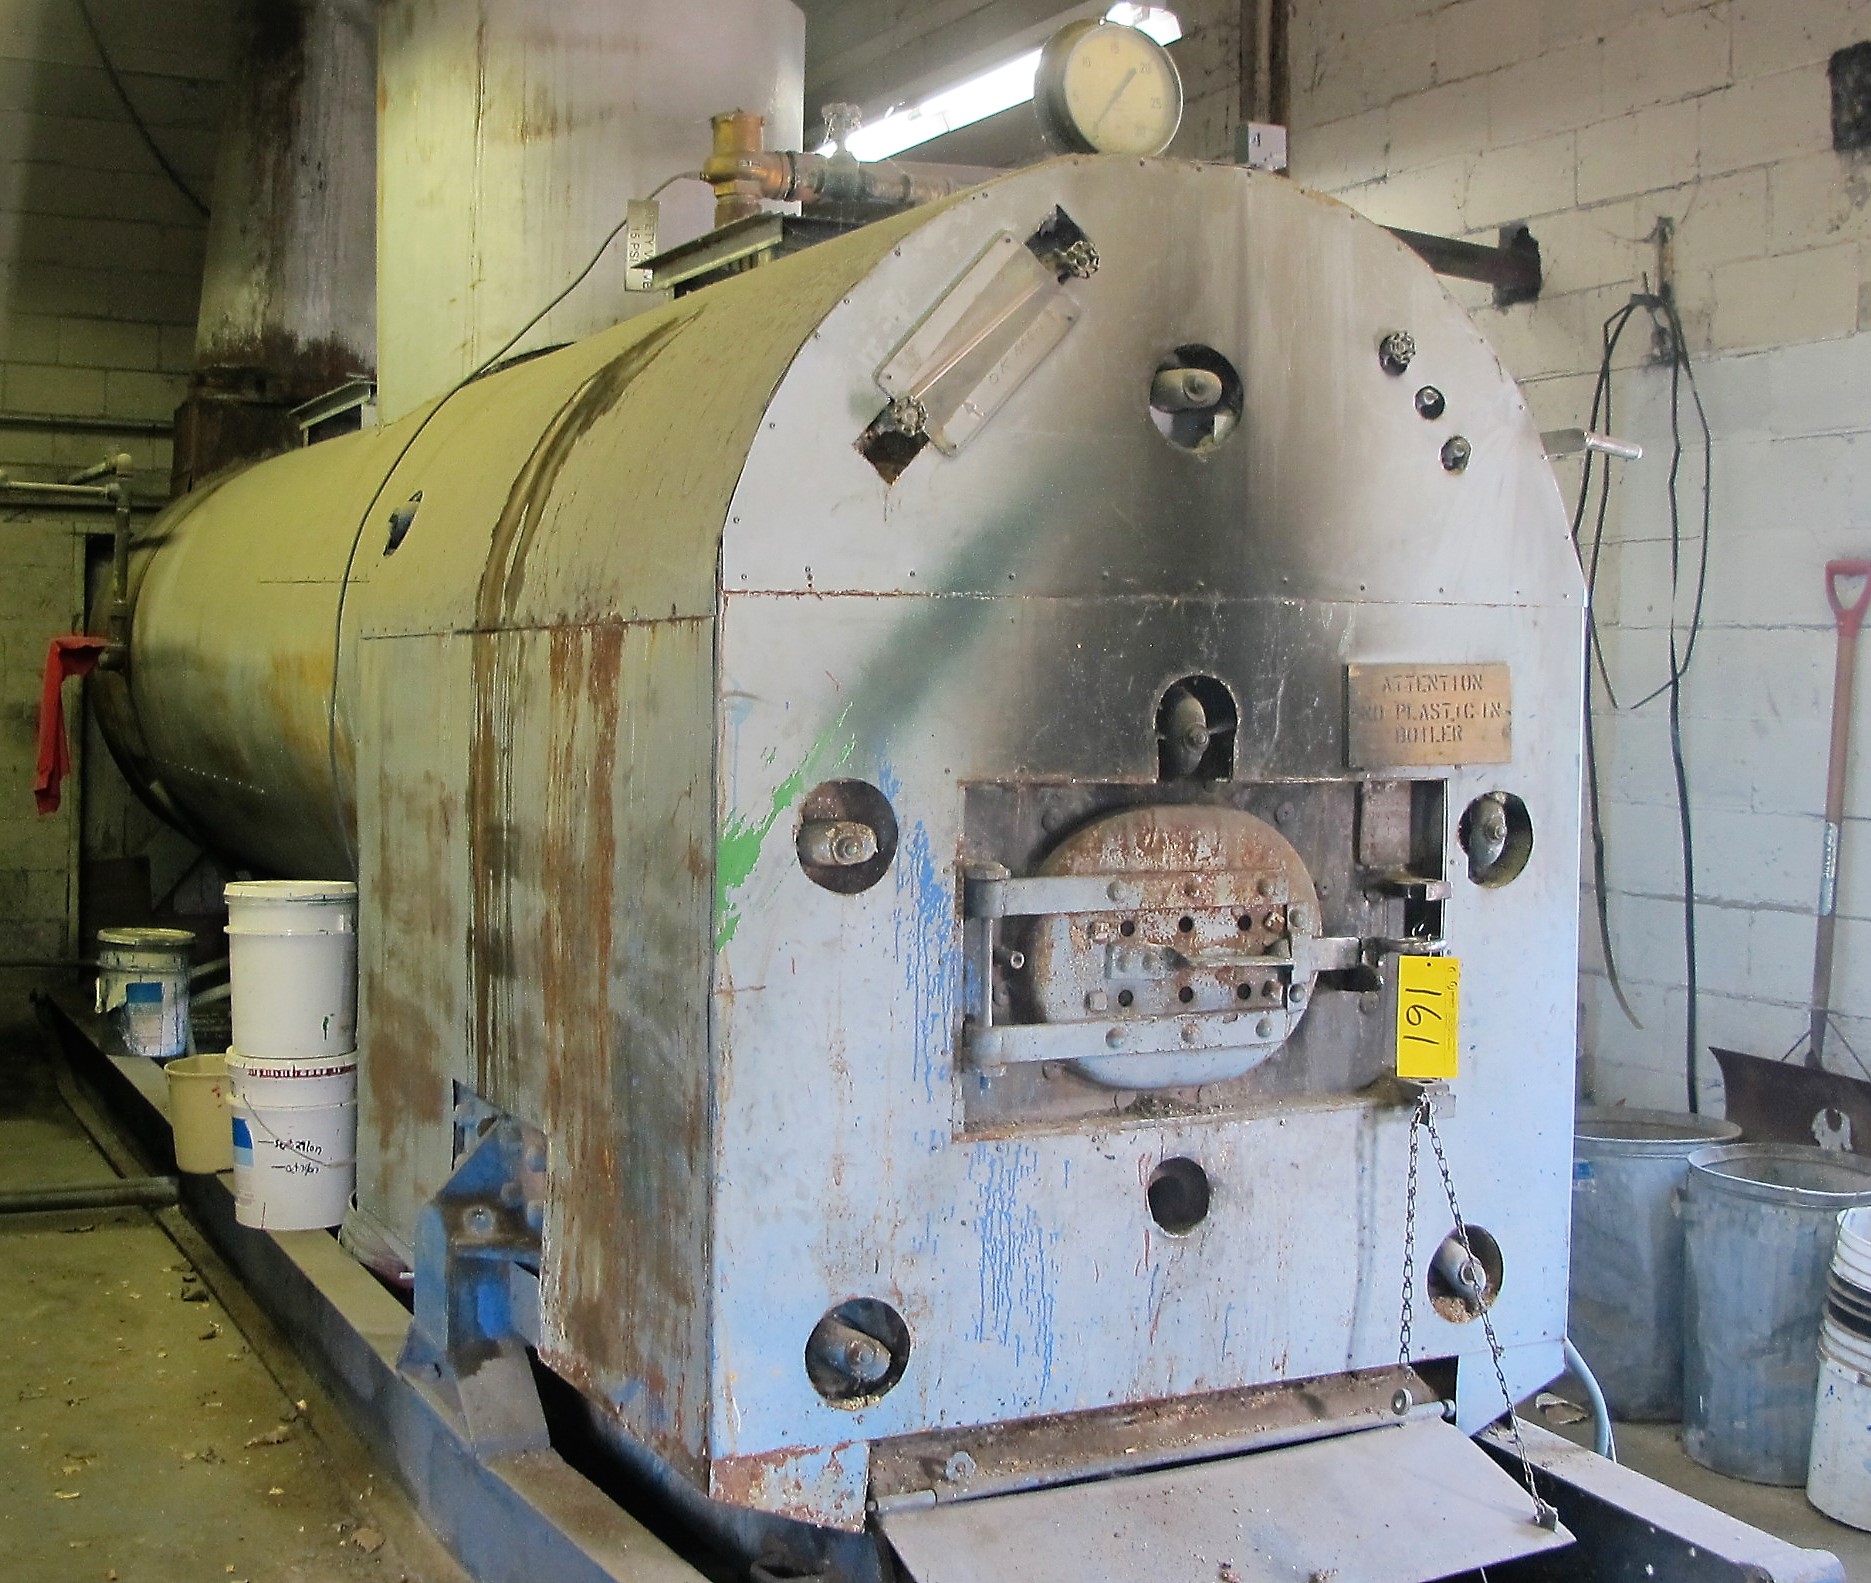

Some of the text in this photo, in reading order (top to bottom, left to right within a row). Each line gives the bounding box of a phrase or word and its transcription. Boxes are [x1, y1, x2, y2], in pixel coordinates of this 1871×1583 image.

[630, 242, 641, 262] PSI
[642, 249, 655, 289] VVE
[1382, 673, 1484, 693] ATTENTION
[1396, 701, 1475, 722] PLASTIC
[1481, 702, 1501, 719] IN
[1395, 723, 1463, 744] BOILER
[1403, 987, 1443, 1045] 191
